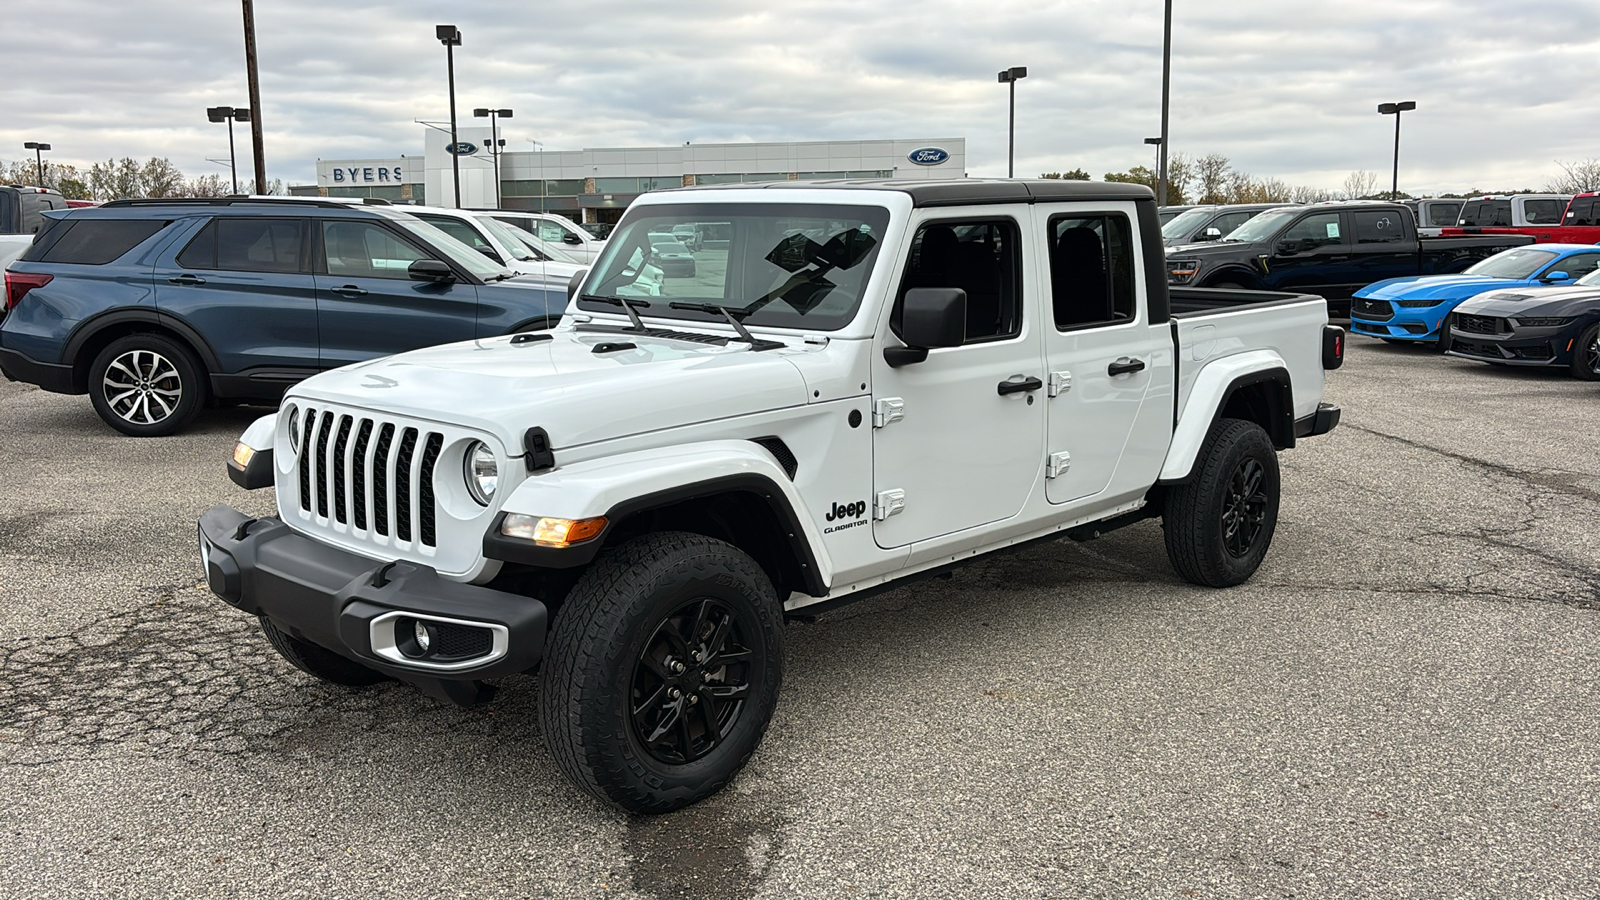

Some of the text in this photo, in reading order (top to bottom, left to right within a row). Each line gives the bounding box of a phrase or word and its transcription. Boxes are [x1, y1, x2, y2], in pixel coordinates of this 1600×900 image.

[916, 150, 941, 161] Ford
[333, 167, 402, 183] BYERS
[825, 500, 866, 522] Jeep
[823, 519, 868, 534] GLADIATOR
